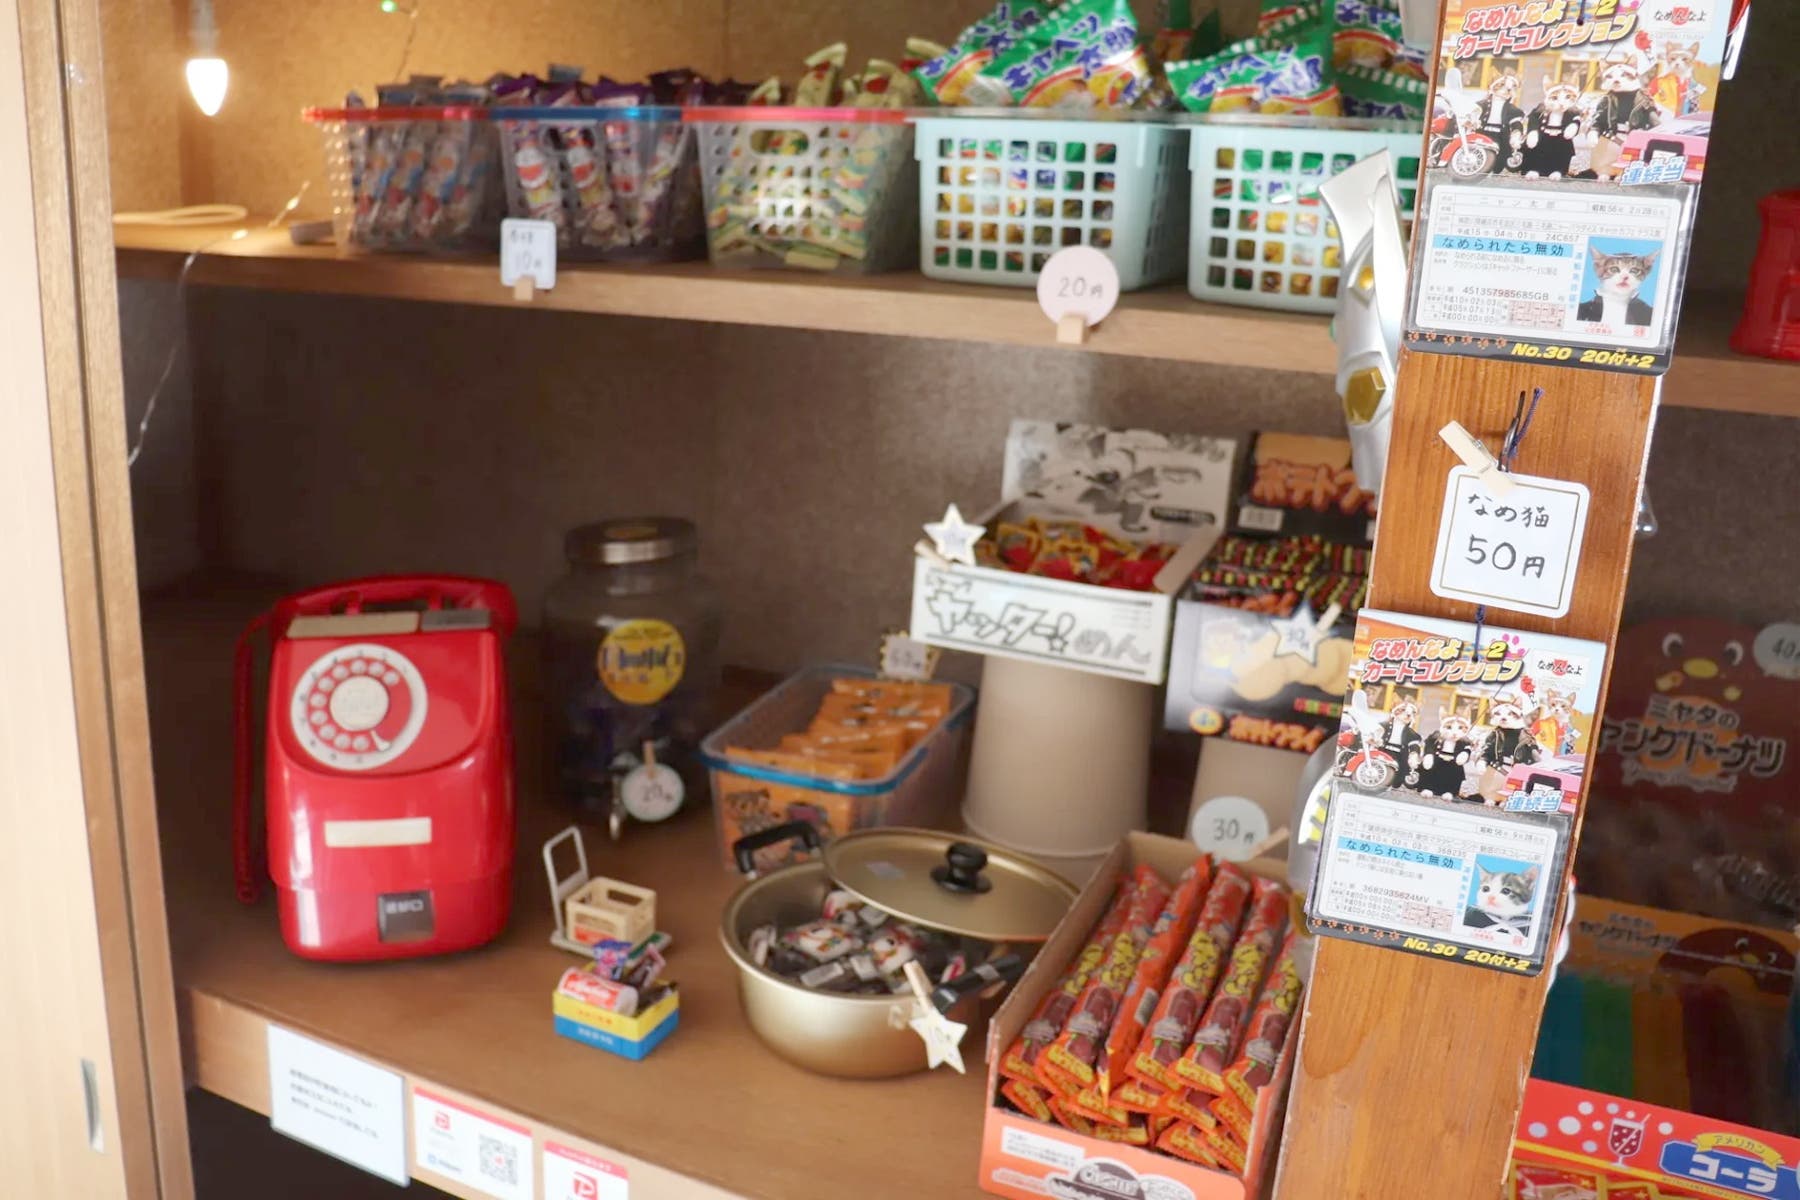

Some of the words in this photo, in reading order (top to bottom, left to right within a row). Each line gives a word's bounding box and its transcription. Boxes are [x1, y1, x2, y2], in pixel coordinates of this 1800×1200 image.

[1463, 0, 1567, 33] なめんなよ
[1654, 7, 1707, 26] なめんなよ
[1453, 13, 1638, 60] カードコレクション
[1441, 236, 1564, 257] なめられたら無効
[1511, 342, 1573, 361] No.30
[1467, 493, 1549, 529] なめ猫
[1464, 534, 1546, 579] 50円
[1370, 638, 1463, 661] なめんなよ
[1487, 640, 1509, 660] 2
[1361, 660, 1523, 683] カードコレクション
[1537, 658, 1583, 677] なめんなよ
[1345, 839, 1455, 870] なめられたら無効
[1402, 937, 1458, 957] No.30
[1713, 1134, 1766, 1155] アメリカン
[1689, 1153, 1778, 1193] コーラ
